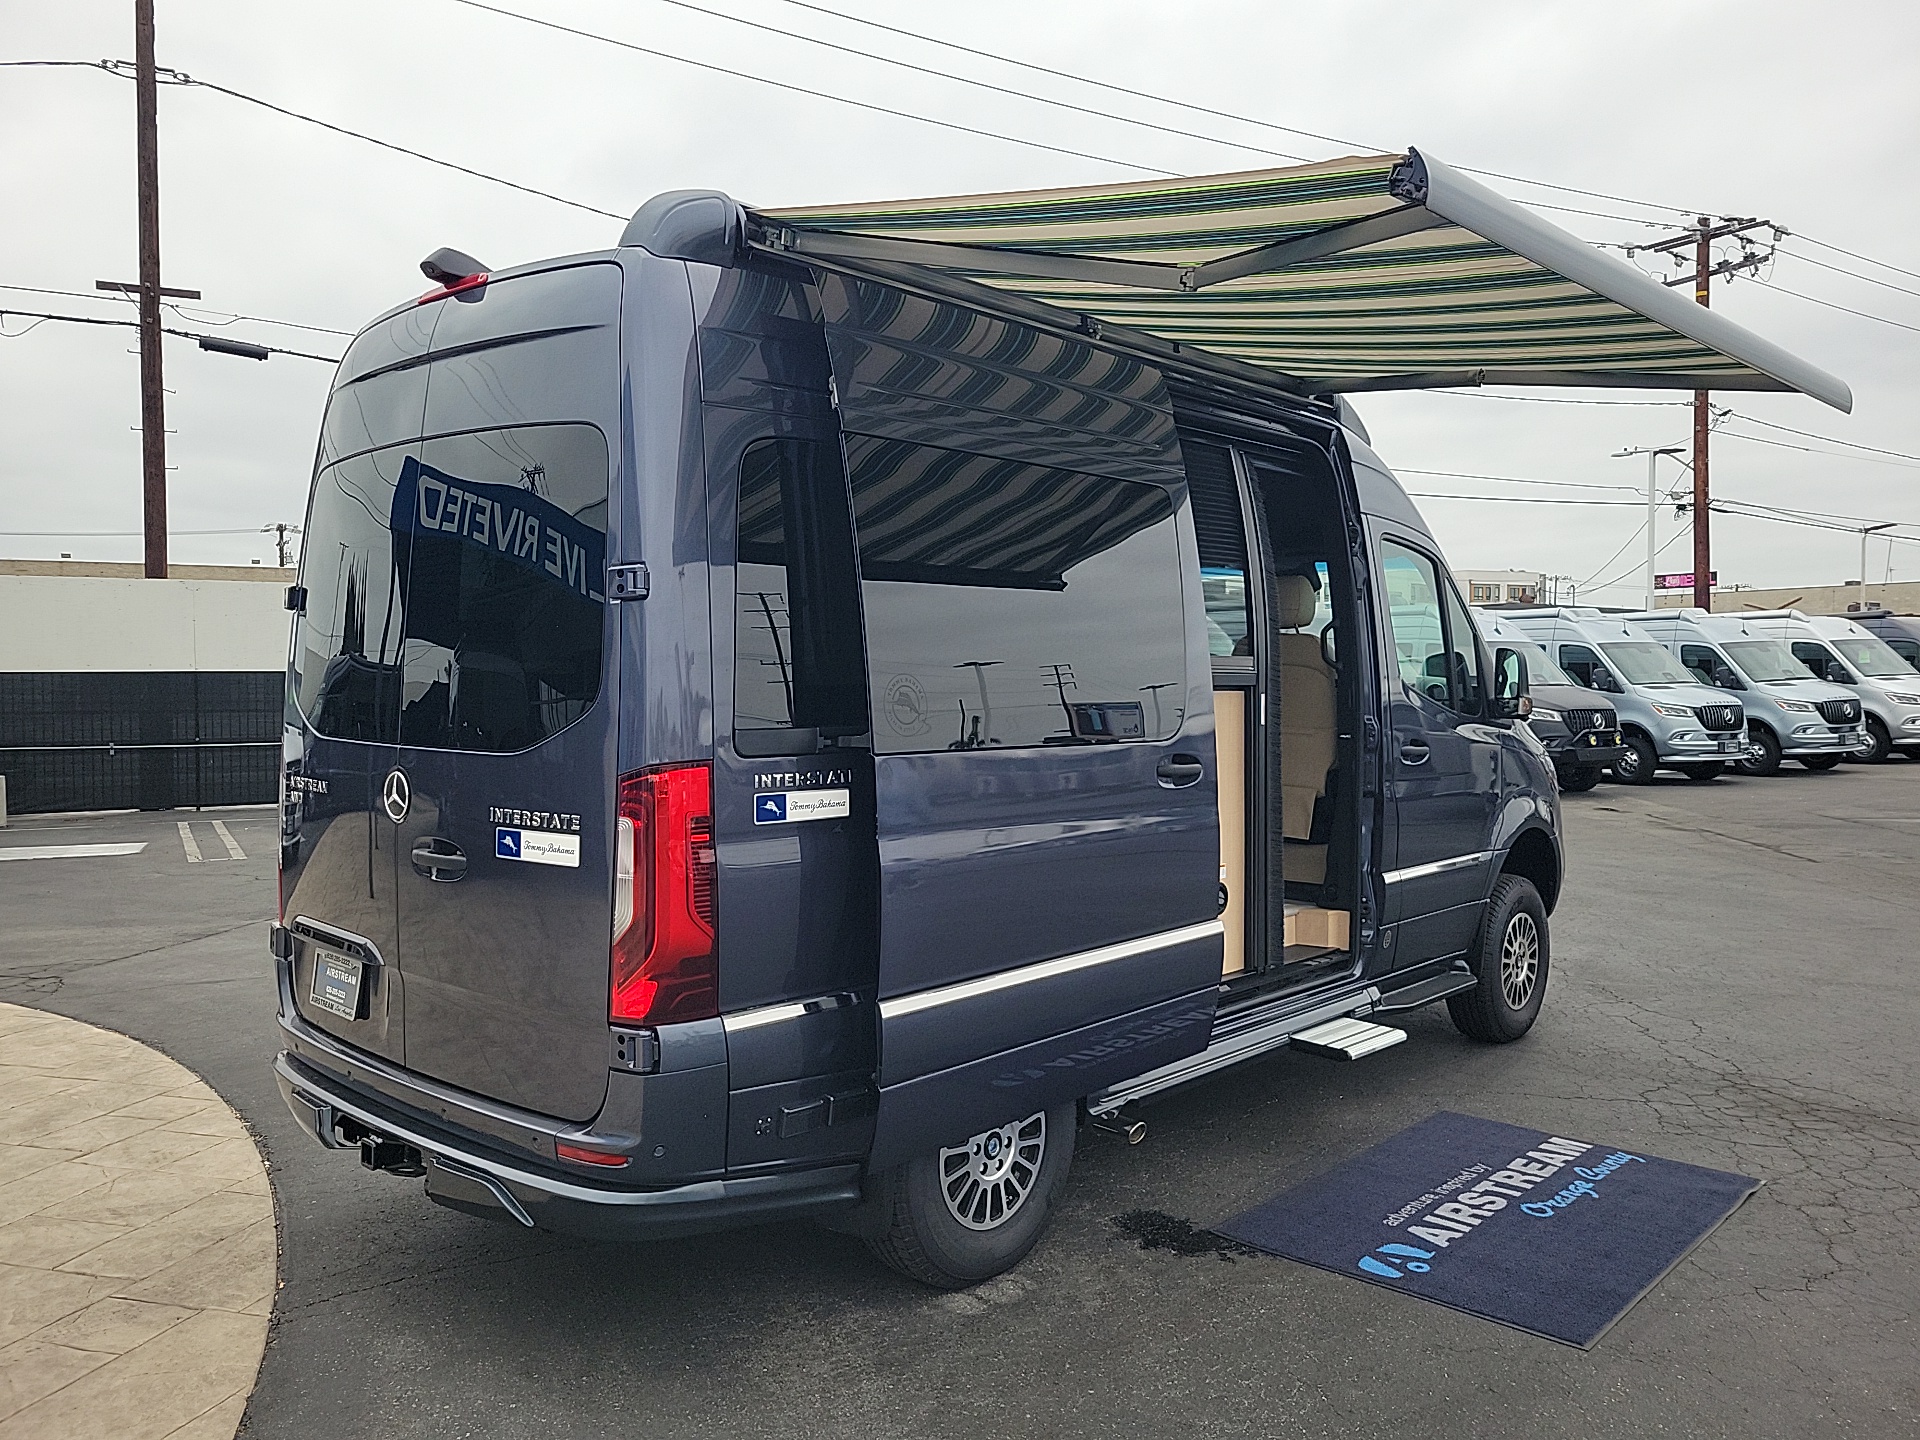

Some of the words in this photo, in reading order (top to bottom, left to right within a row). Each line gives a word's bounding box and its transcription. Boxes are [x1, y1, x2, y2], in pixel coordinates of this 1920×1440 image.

[789, 800, 817, 814] Tommy
[816, 798, 846, 810] Bahama
[489, 806, 581, 831] INTERSTATE
[523, 840, 547, 856] Tommy
[546, 842, 576, 856] Bahama
[326, 967, 357, 986] AIRSTREAM
[311, 996, 335, 1010] AIRSTREAM
[1383, 1192, 1443, 1228] adventure,
[1437, 1167, 1478, 1196] inspired
[1470, 1162, 1493, 1180] by
[1407, 1137, 1596, 1248] AIRSTREAM
[1519, 1179, 1600, 1218] Orange
[1573, 1151, 1647, 1181] County
